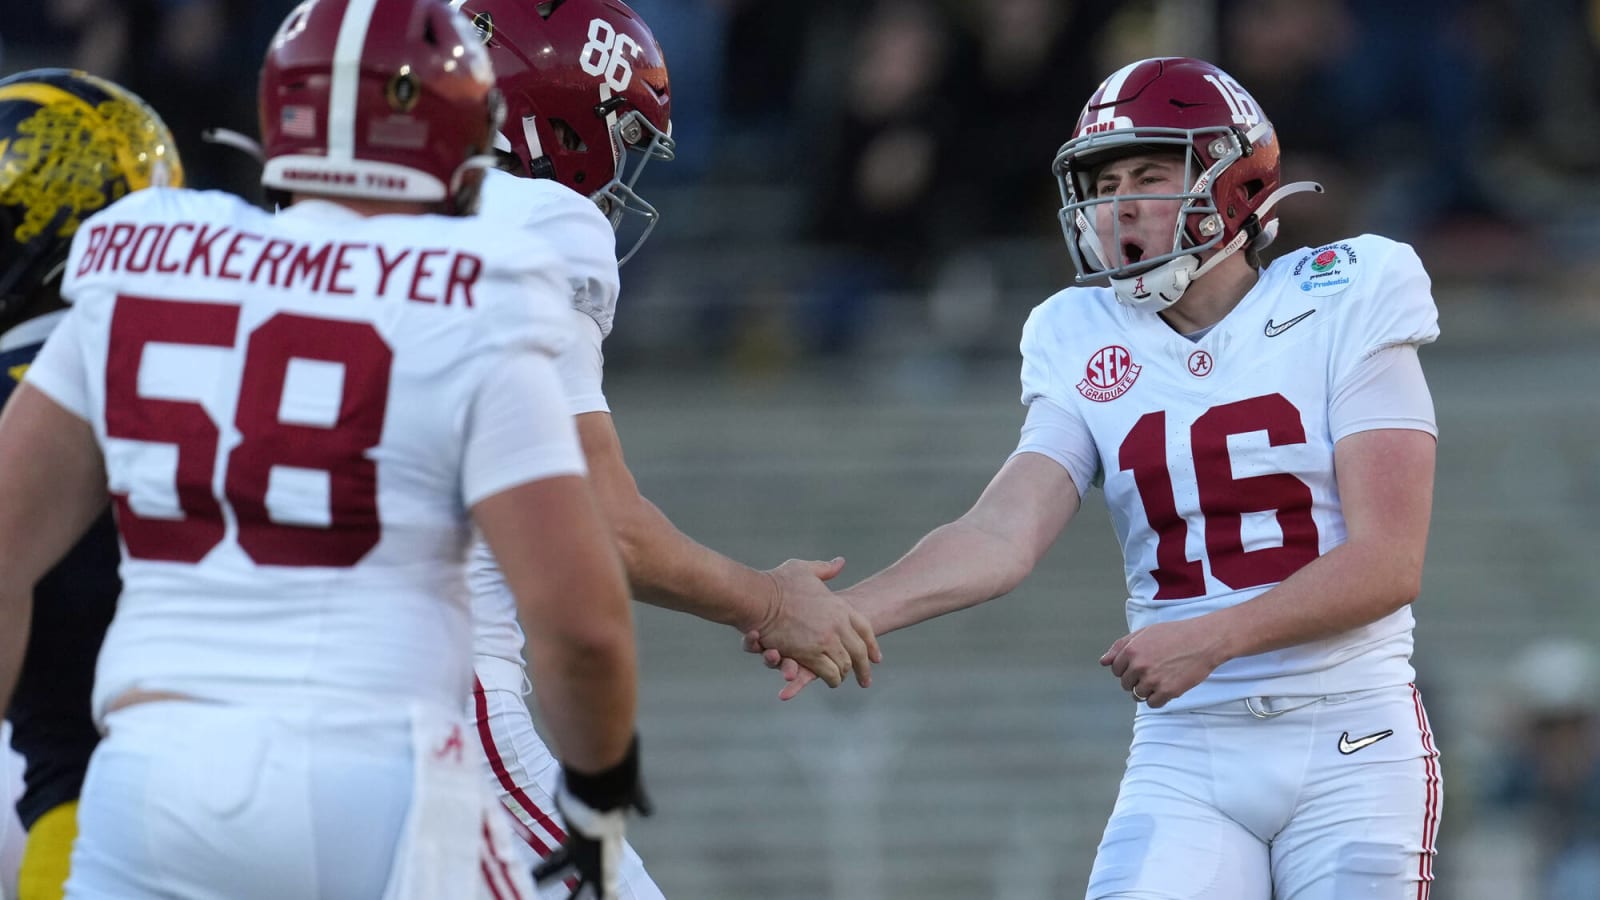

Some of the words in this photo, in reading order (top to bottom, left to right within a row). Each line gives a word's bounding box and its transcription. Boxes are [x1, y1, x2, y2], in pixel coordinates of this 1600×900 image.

[579, 18, 638, 92] 86
[1203, 74, 1259, 124] 16
[76, 222, 483, 308] BROCKERMEYER
[1294, 255, 1310, 276] ROSE
[1340, 244, 1357, 265] GAME
[1313, 277, 1349, 288] Prudential
[1088, 347, 1128, 387] SEC
[1192, 353, 1208, 372] A
[1085, 376, 1133, 401] GRADUATE
[105, 294, 394, 568] 58
[1118, 392, 1320, 600] 16
